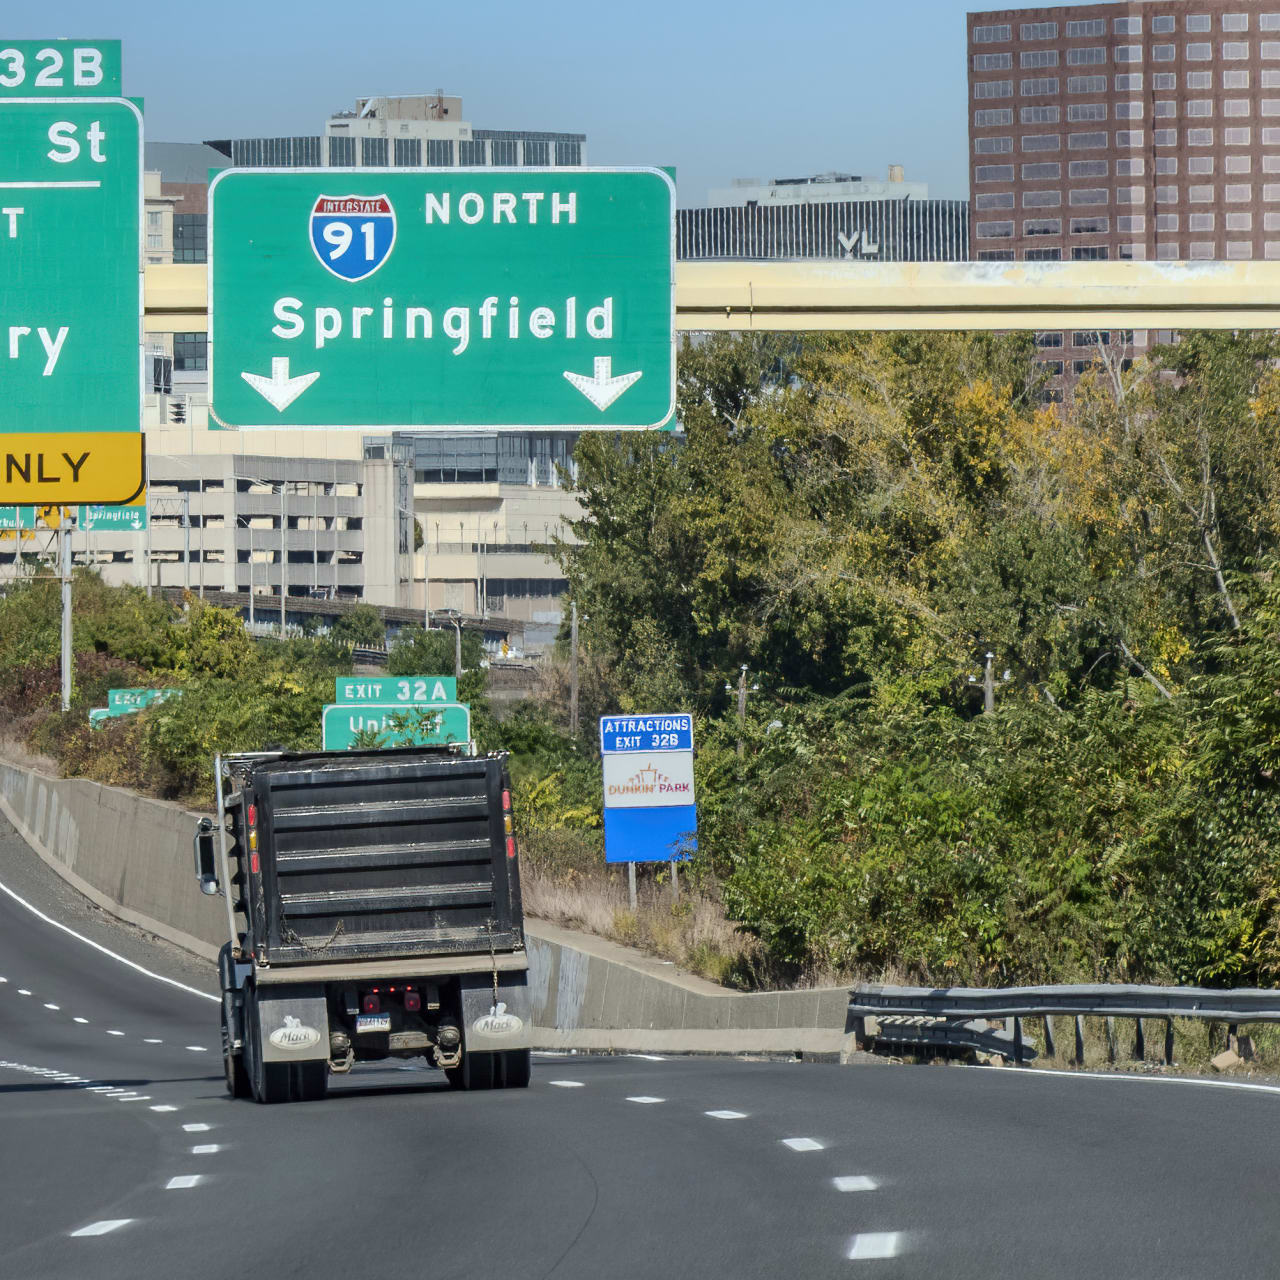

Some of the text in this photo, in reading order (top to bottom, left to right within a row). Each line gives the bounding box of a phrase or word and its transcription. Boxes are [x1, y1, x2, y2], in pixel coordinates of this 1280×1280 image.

[47, 120, 107, 164] St
[324, 200, 382, 213] INTERSTATE
[425, 192, 578, 224] NORTH
[323, 222, 375, 260] 91
[272, 296, 614, 355] Springfield
[344, 680, 447, 701] EXIT 32A
[605, 719, 689, 734] ATTRACTIONS
[616, 733, 679, 748] EXIT 32B
[608, 783, 690, 795] DUNKIN' PARK
[280, 1031, 310, 1043] Mack
